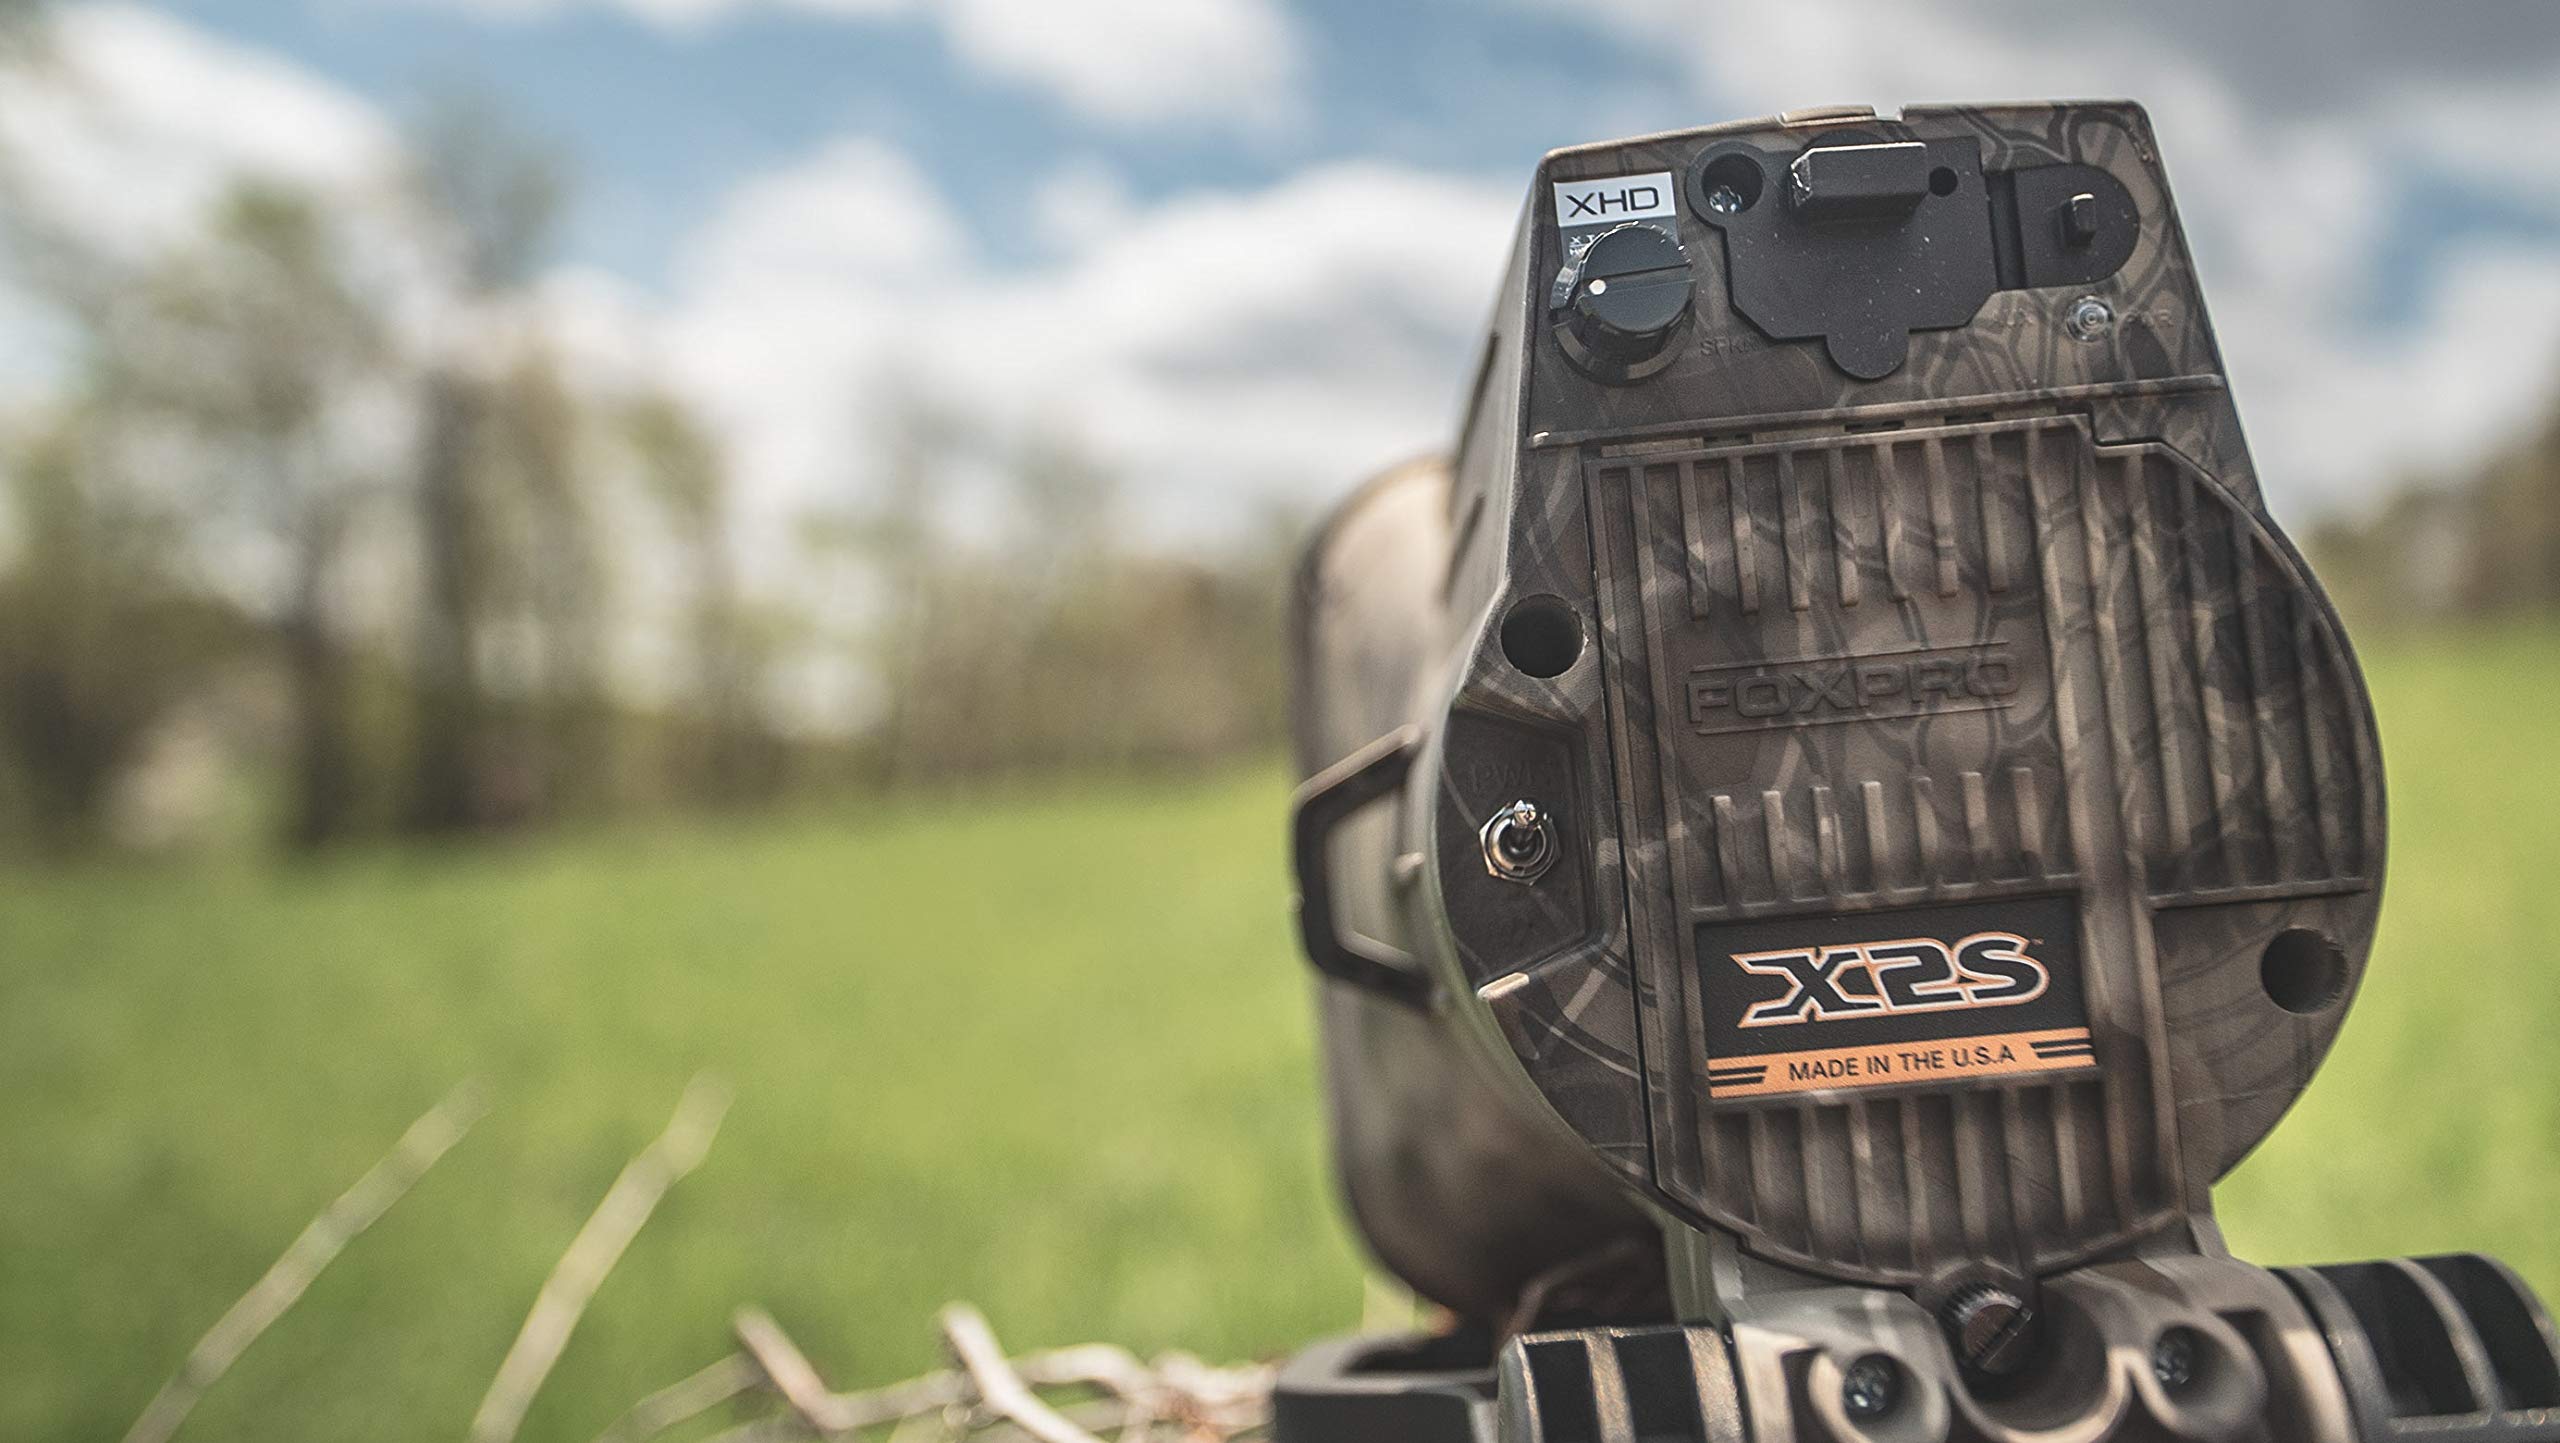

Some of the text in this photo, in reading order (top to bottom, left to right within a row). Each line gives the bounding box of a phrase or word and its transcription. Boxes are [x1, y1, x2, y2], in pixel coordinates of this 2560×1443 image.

[1565, 186, 1659, 217] XHD
[1686, 653, 2019, 724] FOXPRO
[1730, 931, 2050, 1028] X2S
[1789, 1045, 2016, 1081] MADE IN THE U.S.A
